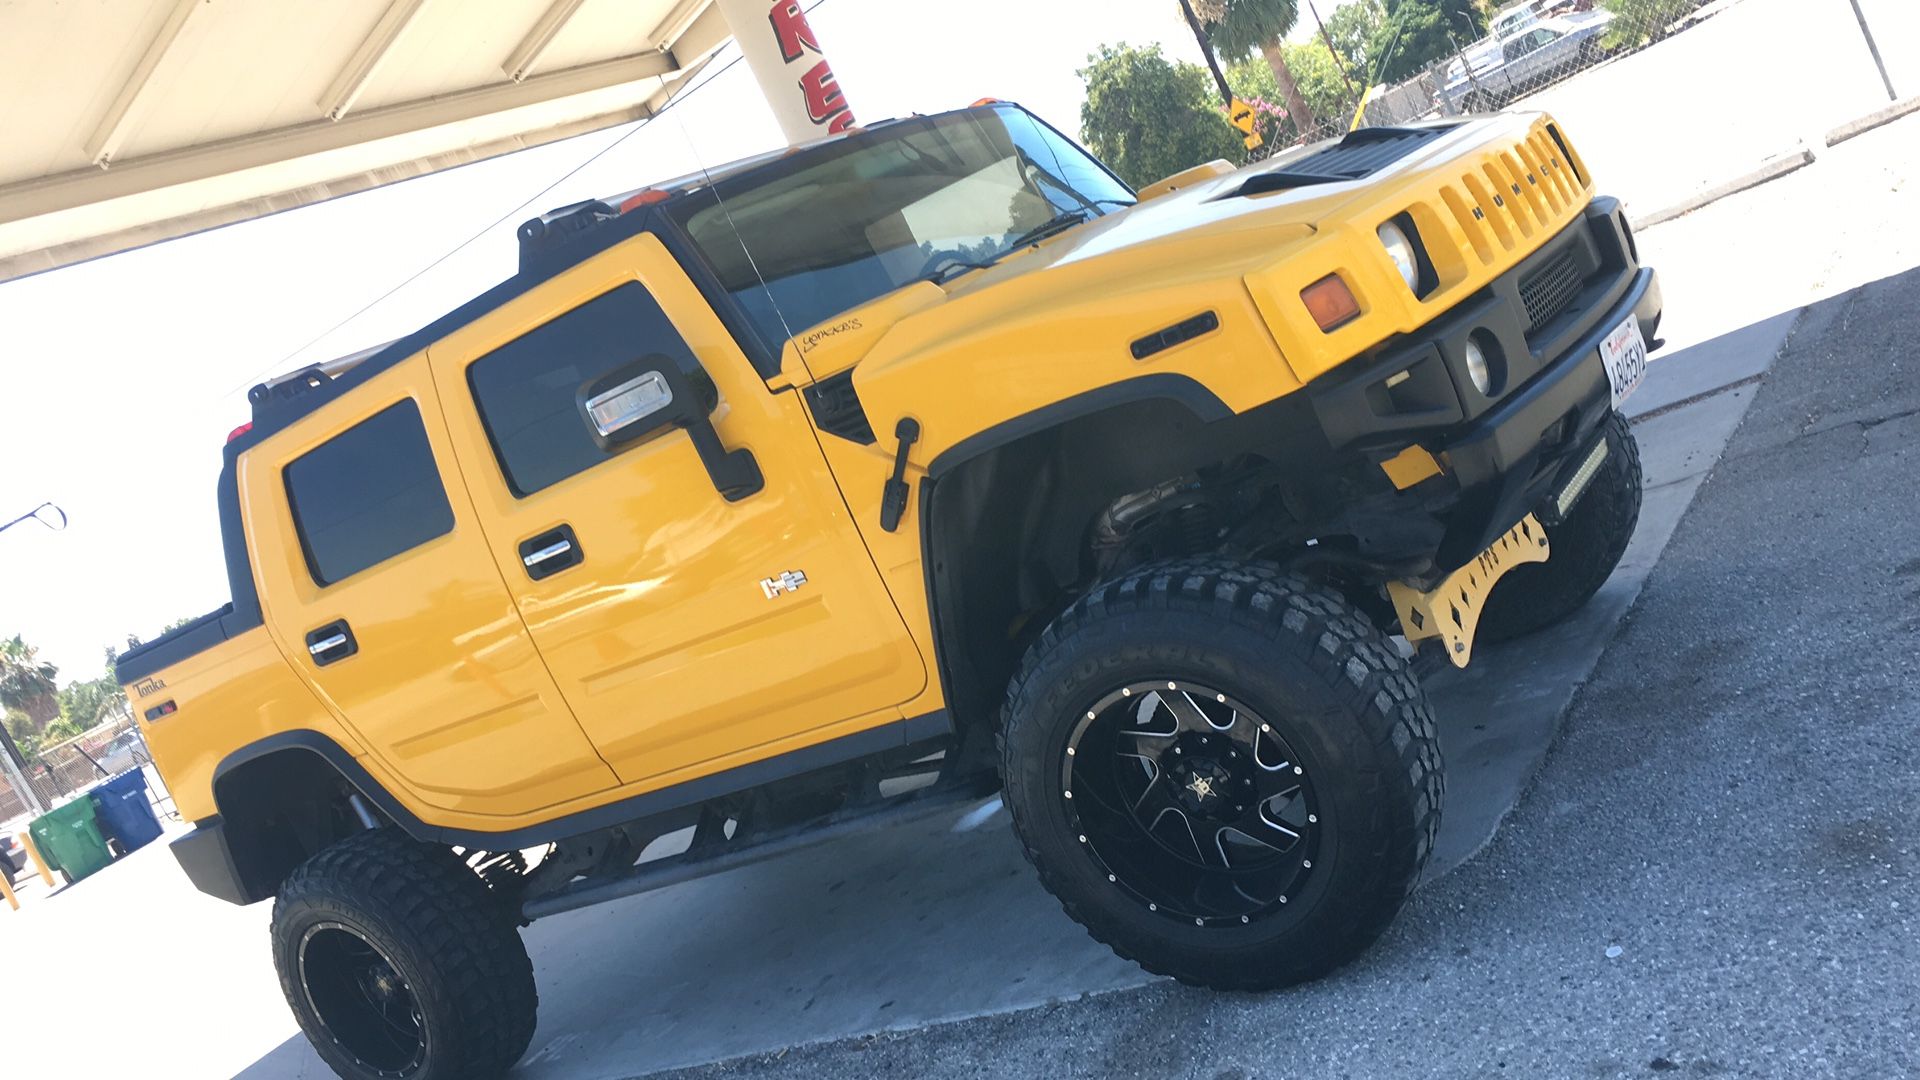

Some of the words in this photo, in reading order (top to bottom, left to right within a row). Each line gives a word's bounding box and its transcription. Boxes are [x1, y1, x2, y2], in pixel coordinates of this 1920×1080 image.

[1472, 158, 1559, 221] HUMMER
[760, 569, 808, 600] H2
[132, 676, 167, 698] Tonka
